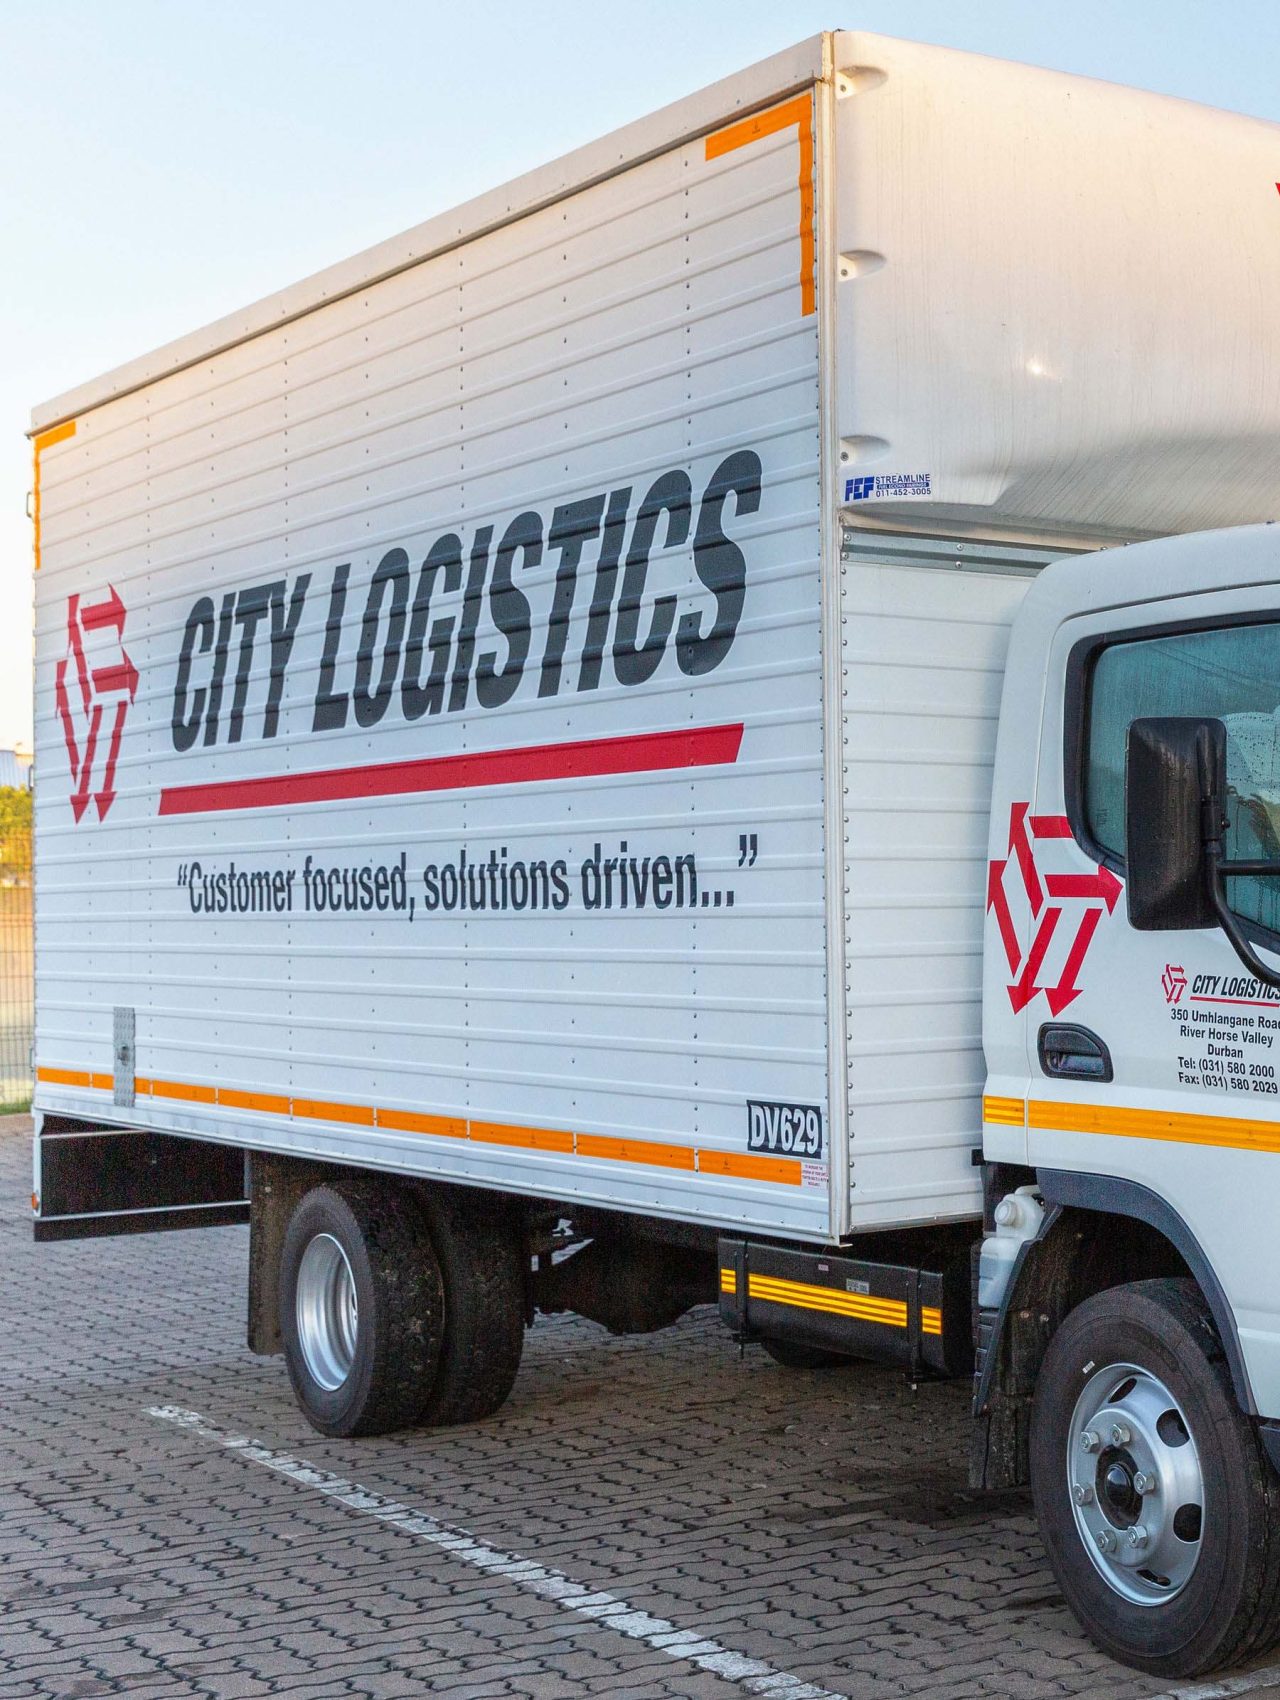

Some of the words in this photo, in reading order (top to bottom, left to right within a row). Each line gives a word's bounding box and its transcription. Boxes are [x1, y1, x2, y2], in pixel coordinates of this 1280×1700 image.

[875, 473, 931, 485] STREAMLINE
[875, 488, 932, 498] 011-452-3005
[171, 573, 313, 752] CITY
[312, 450, 763, 732] LOGISTICS
[303, 852, 415, 923] focused,
[423, 847, 569, 911] solutions
[1192, 974, 1221, 994] CITY
[1170, 1008, 1189, 1021] 350
[1191, 1010, 1255, 1028] Umhlangane
[1180, 1025, 1205, 1039] River
[1208, 1027, 1239, 1042] Horse
[1241, 1030, 1274, 1048] Valley
[1207, 1043, 1244, 1059] Durban
[1177, 1056, 1196, 1070] Tel:
[1198, 1058, 1224, 1076] (031)
[1227, 1061, 1246, 1075] 580
[1248, 1064, 1275, 1078] 2000
[1178, 1071, 1200, 1085] Fax:
[1202, 1073, 1228, 1091] (031)
[1230, 1077, 1250, 1091] 580
[1252, 1080, 1279, 1094] 2029
[749, 1104, 820, 1155] DV629
